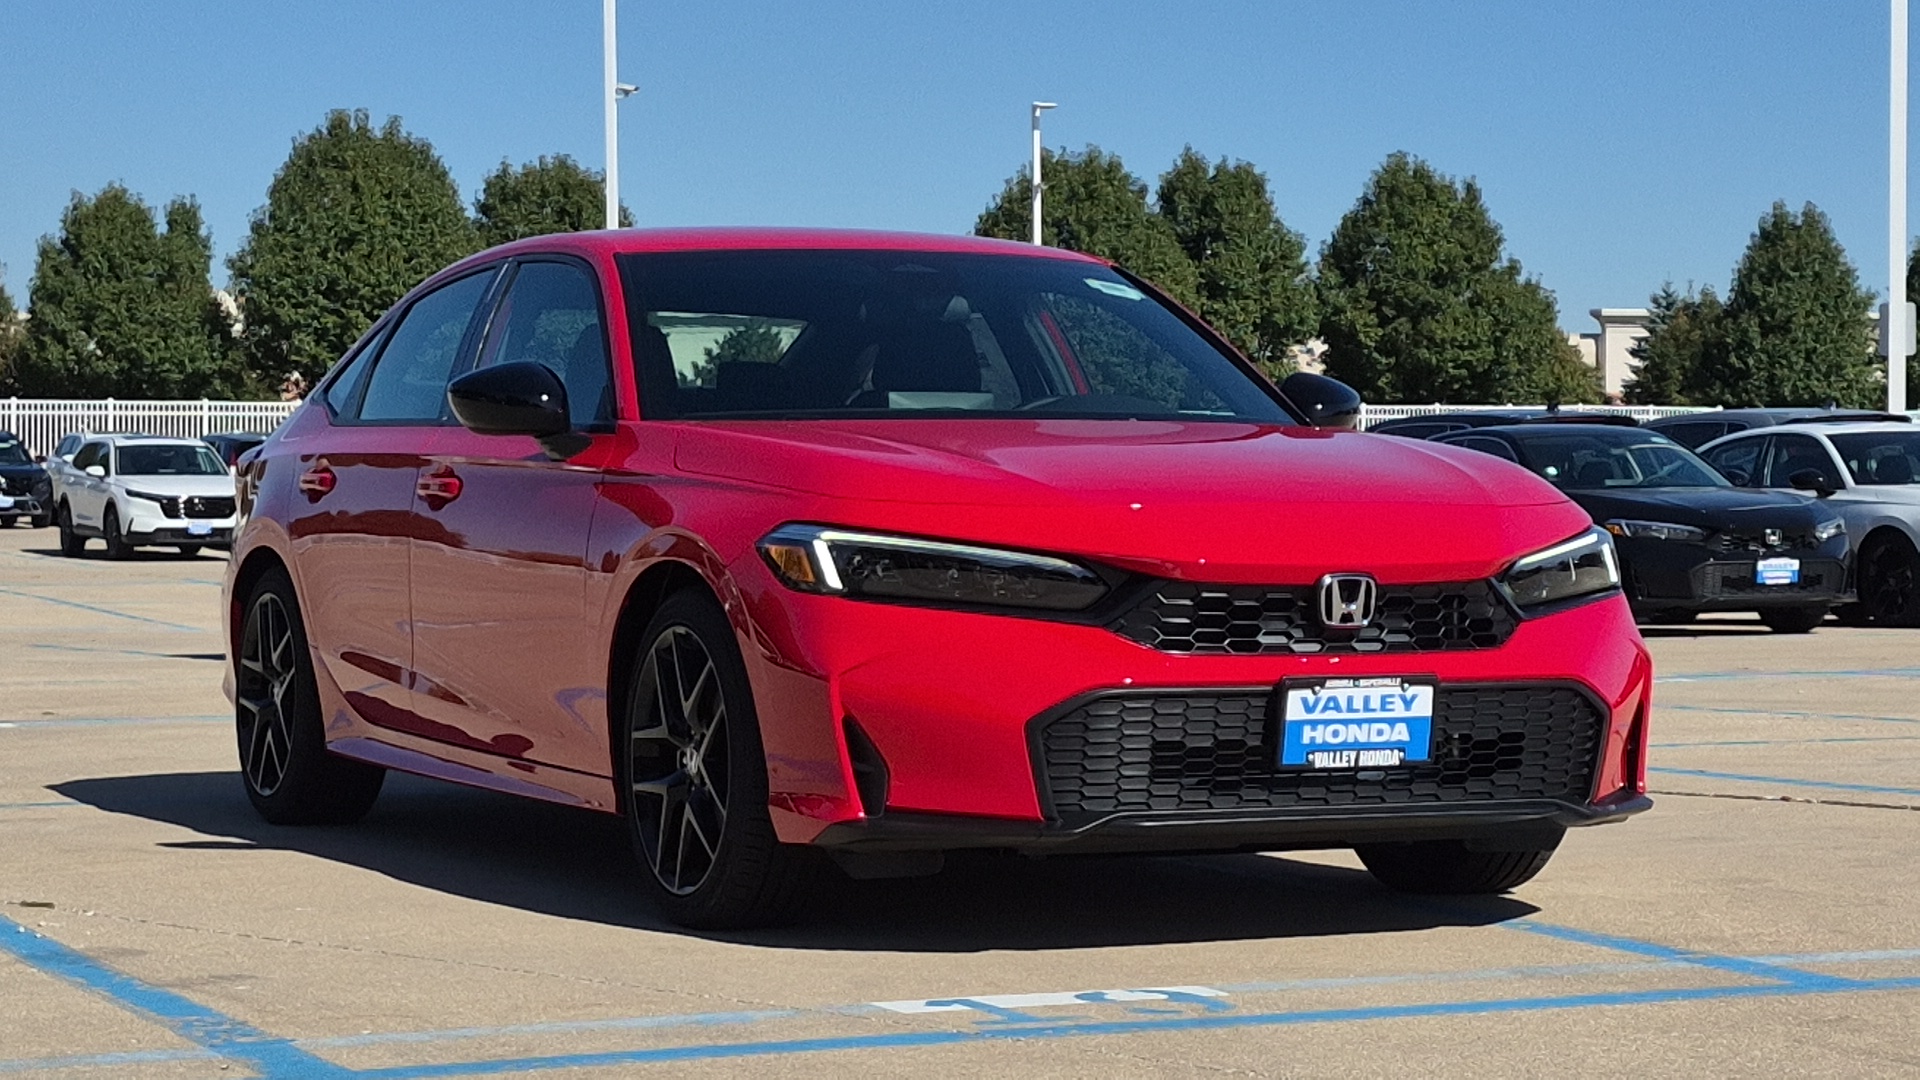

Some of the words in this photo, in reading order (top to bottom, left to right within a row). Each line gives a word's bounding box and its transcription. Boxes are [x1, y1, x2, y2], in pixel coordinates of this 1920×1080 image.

[1300, 693, 1419, 715] VALLEY
[1301, 722, 1411, 745] HONDA
[1314, 750, 1357, 769] VALLEY
[1358, 749, 1400, 767] HONDA
